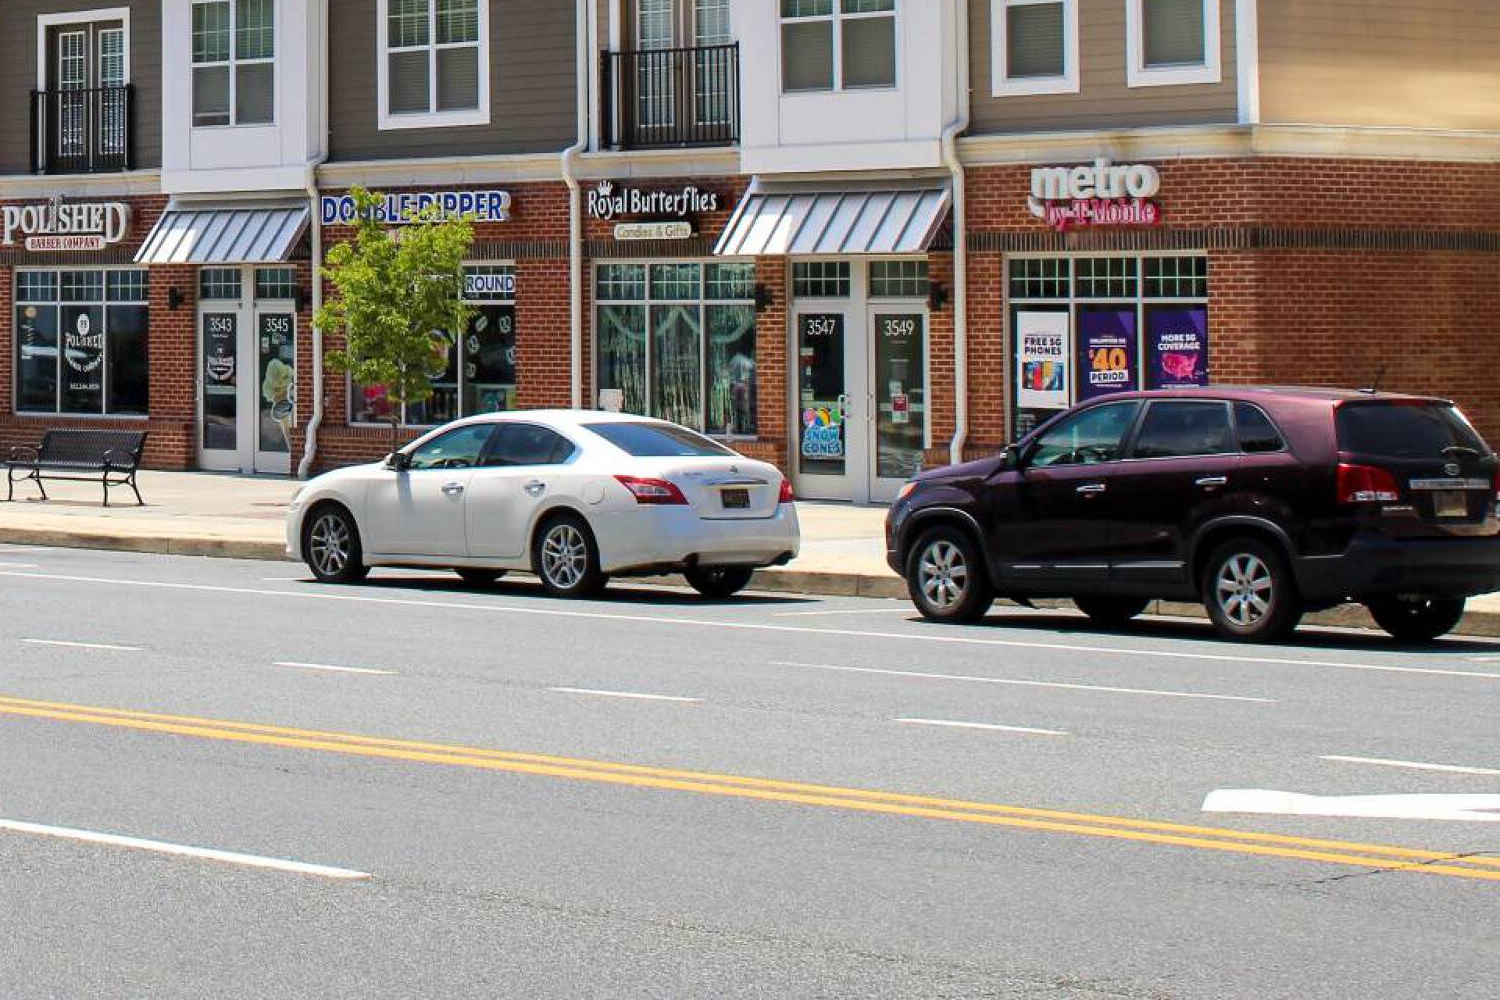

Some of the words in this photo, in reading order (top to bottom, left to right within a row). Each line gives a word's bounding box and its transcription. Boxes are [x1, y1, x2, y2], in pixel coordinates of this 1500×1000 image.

[1030, 157, 1160, 200] metro
[322, 195, 413, 223] DOBLE
[587, 188, 627, 220] Royal
[630, 187, 717, 216] Butterflies
[2, 200, 127, 245] POLISHED
[30, 239, 61, 249] BARBER
[63, 238, 101, 249] COMPANY
[466, 275, 515, 292] ROUND
[210, 318, 232, 332] 3543
[265, 318, 288, 332] 3545
[807, 319, 836, 335] 3547
[884, 319, 915, 337] 3549
[1024, 337, 1048, 346] FREE
[1160, 334, 1184, 342] MORE
[1024, 346, 1062, 355] PHONES
[806, 425, 839, 440] SNOW
[804, 441, 840, 454] CONES
